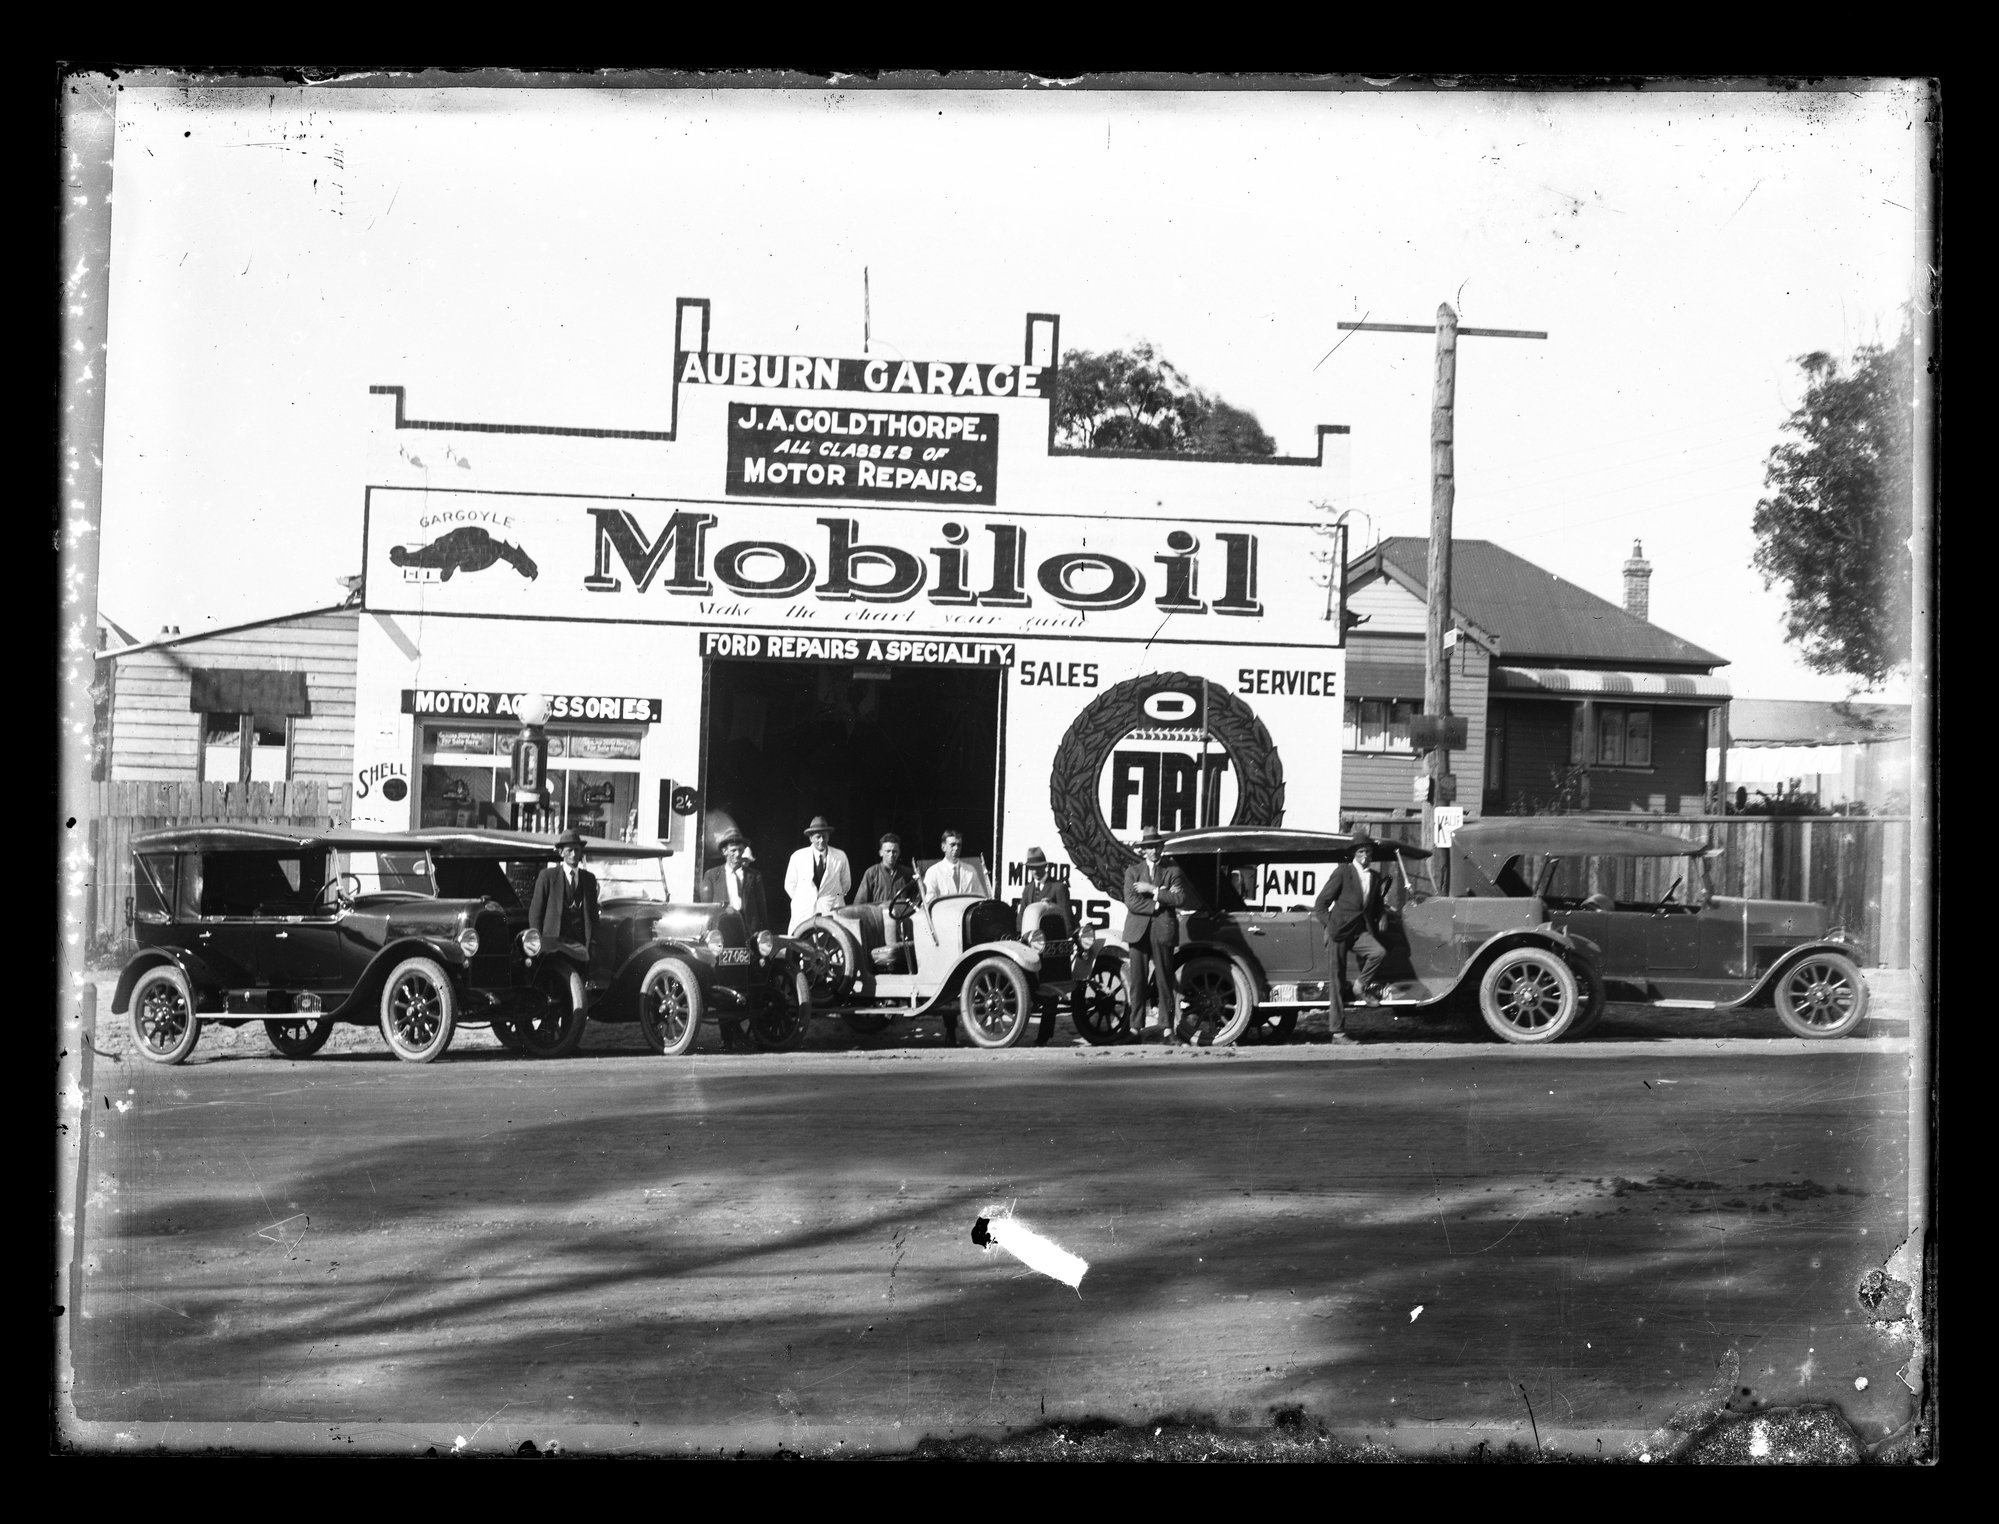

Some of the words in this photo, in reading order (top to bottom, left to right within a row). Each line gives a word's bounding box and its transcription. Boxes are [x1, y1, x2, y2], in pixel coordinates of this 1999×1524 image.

[680, 352, 840, 390] AUBURN
[863, 360, 1043, 397] GARAGE
[773, 439, 811, 455] ALL
[818, 441, 913, 461] CLASSES
[922, 447, 950, 462] OF
[743, 457, 846, 486] MOTOR
[857, 460, 984, 494] REPAIRS.
[420, 510, 515, 528] GARGOYLE
[583, 507, 1264, 616] Mobiloil
[699, 602, 757, 617] Make
[785, 605, 818, 619] the
[844, 608, 917, 622] chart
[944, 613, 1004, 627] your
[1018, 613, 1090, 632] guide
[705, 633, 761, 656] FORD
[766, 636, 860, 660] REPAIRS
[1020, 661, 1099, 687] SALES
[1238, 668, 1337, 697] SERVICE
[415, 691, 490, 714] MOTOR
[495, 693, 658, 721] ACSSORIES.
[356, 762, 408, 799] SHELL
[1111, 750, 1232, 832] FIAT
[1264, 869, 1316, 896] AND
